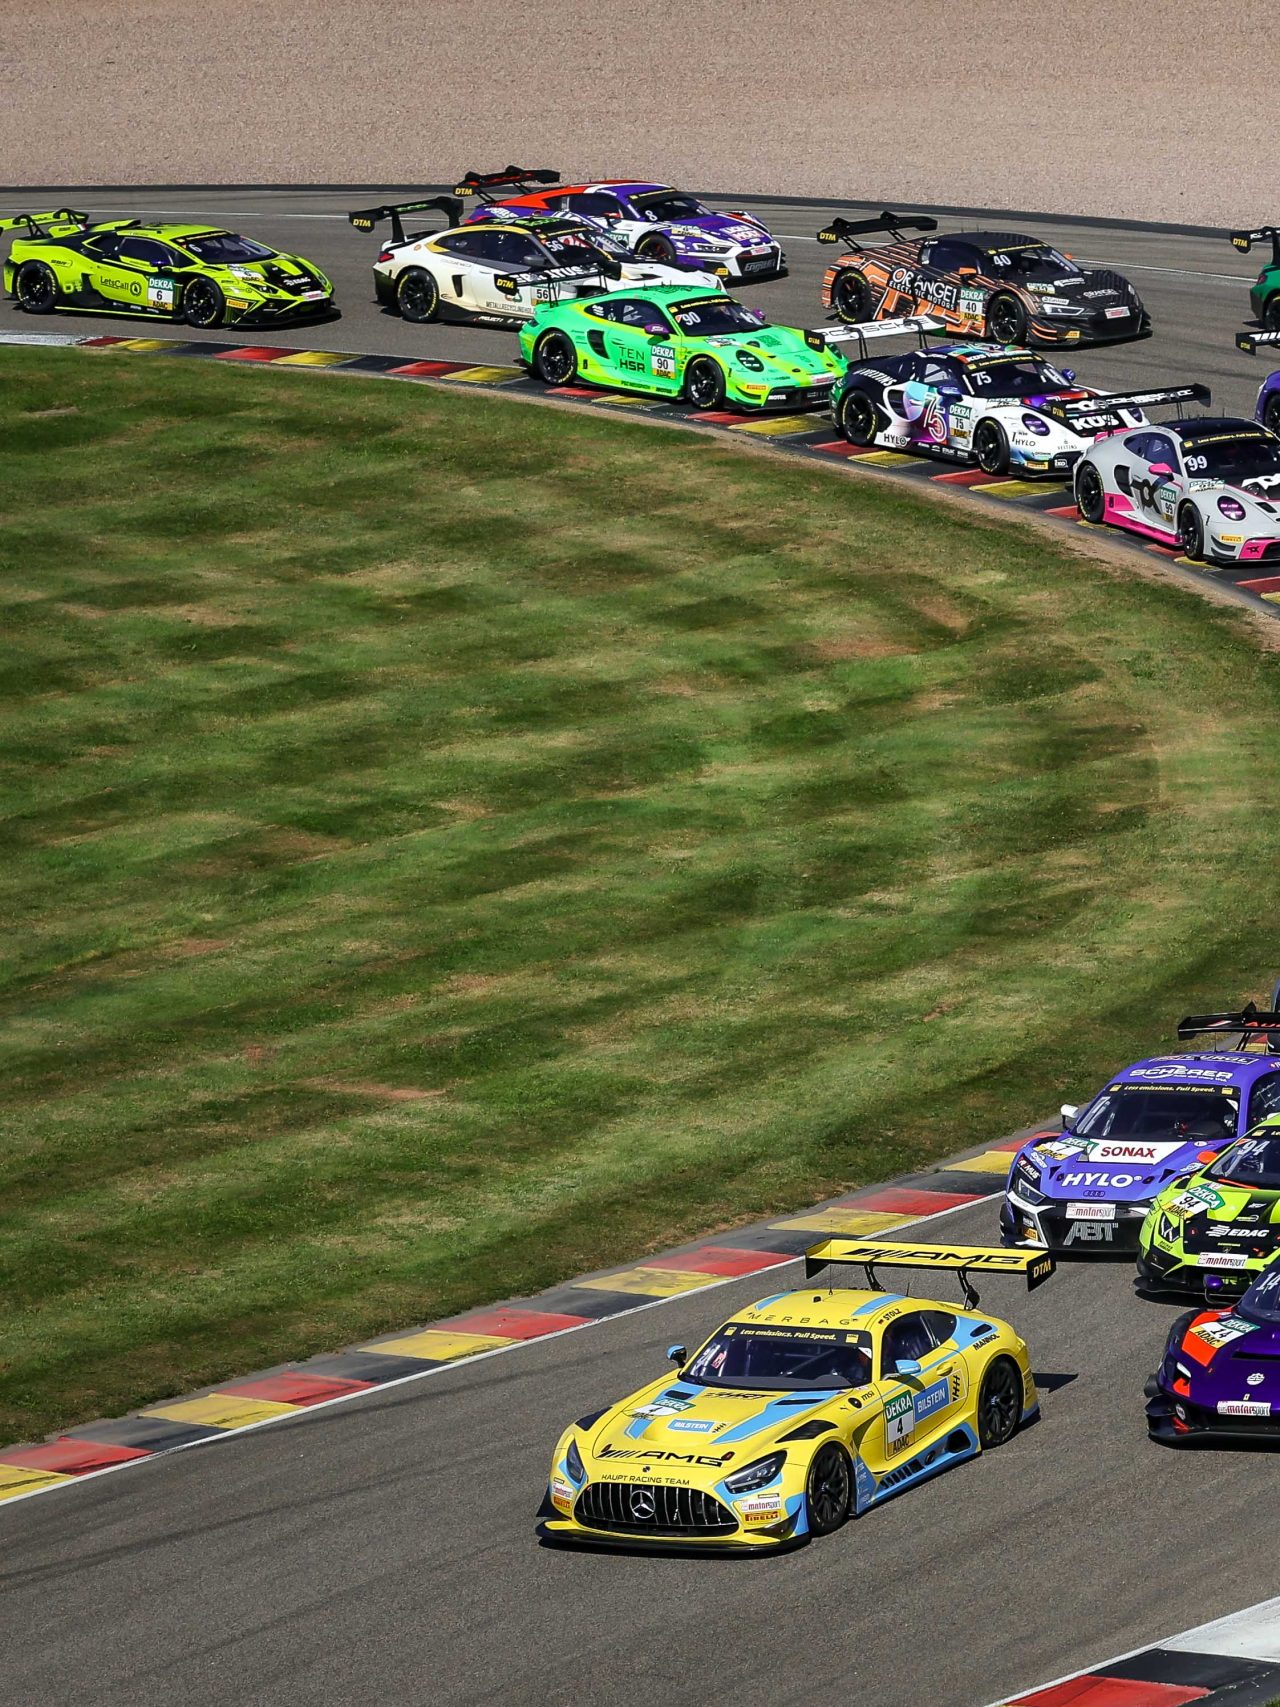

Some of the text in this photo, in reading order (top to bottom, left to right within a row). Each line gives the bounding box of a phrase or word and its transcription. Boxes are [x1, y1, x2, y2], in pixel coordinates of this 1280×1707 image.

[454, 187, 473, 196] DTM
[645, 210, 658, 221] 8
[353, 218, 372, 228] DTM
[819, 232, 836, 241] DTM
[1233, 237, 1247, 248] DTM
[546, 240, 564, 251] 56
[993, 255, 1011, 266] 40
[100, 276, 129, 290] LetsCall
[150, 279, 173, 289] DEKRA
[497, 279, 514, 289] DTM
[156, 290, 163, 300] 6
[536, 289, 548, 299] 56
[961, 290, 983, 300] DEKRA
[928, 293, 955, 310] MOTORS
[965, 302, 977, 312] 40
[682, 312, 701, 325] 90
[620, 348, 645, 360] TEN
[652, 346, 674, 358] DEKRA
[620, 359, 646, 373] HSR
[657, 358, 669, 369] 90
[972, 372, 992, 386] 75
[950, 405, 971, 418] DEKRA
[955, 418, 964, 429] 75
[1016, 439, 1036, 447] HYLO
[1188, 456, 1208, 471] 99
[1160, 489, 1176, 501] DEKRA
[1165, 504, 1174, 514] 99
[1129, 1067, 1233, 1079] SCHERER
[1100, 1146, 1157, 1158] SONAX
[1239, 1140, 1270, 1156] 94
[1179, 1196, 1201, 1208] 94
[1189, 1186, 1221, 1207] DEKRA
[1166, 1205, 1190, 1216] ADAC
[1063, 1221, 1118, 1246] ABT
[907, 1252, 1024, 1264] AMG
[1032, 1260, 1052, 1279] DTM
[749, 1313, 851, 1325] MERBAG
[883, 1308, 902, 1321] STOLZ
[1223, 1318, 1257, 1333] DEKRA
[794, 1331, 811, 1340] Full
[811, 1333, 837, 1342] Speed.
[1194, 1328, 1221, 1346] ADAC
[1210, 1327, 1227, 1338] 14
[973, 1333, 1000, 1351] MANNOL
[861, 1391, 875, 1401] msi
[917, 1388, 946, 1413] BILSTEIN
[659, 1399, 690, 1410] DEKRA
[886, 1394, 912, 1419] DEKRA
[896, 1419, 903, 1434] 4
[892, 1435, 910, 1453] ADAC
[639, 1451, 725, 1467] AMG
[629, 1476, 663, 1484] RACING
[664, 1477, 690, 1485] TEAM
[748, 1500, 781, 1510] motorsport
[745, 1511, 779, 1522] PIRELLI
